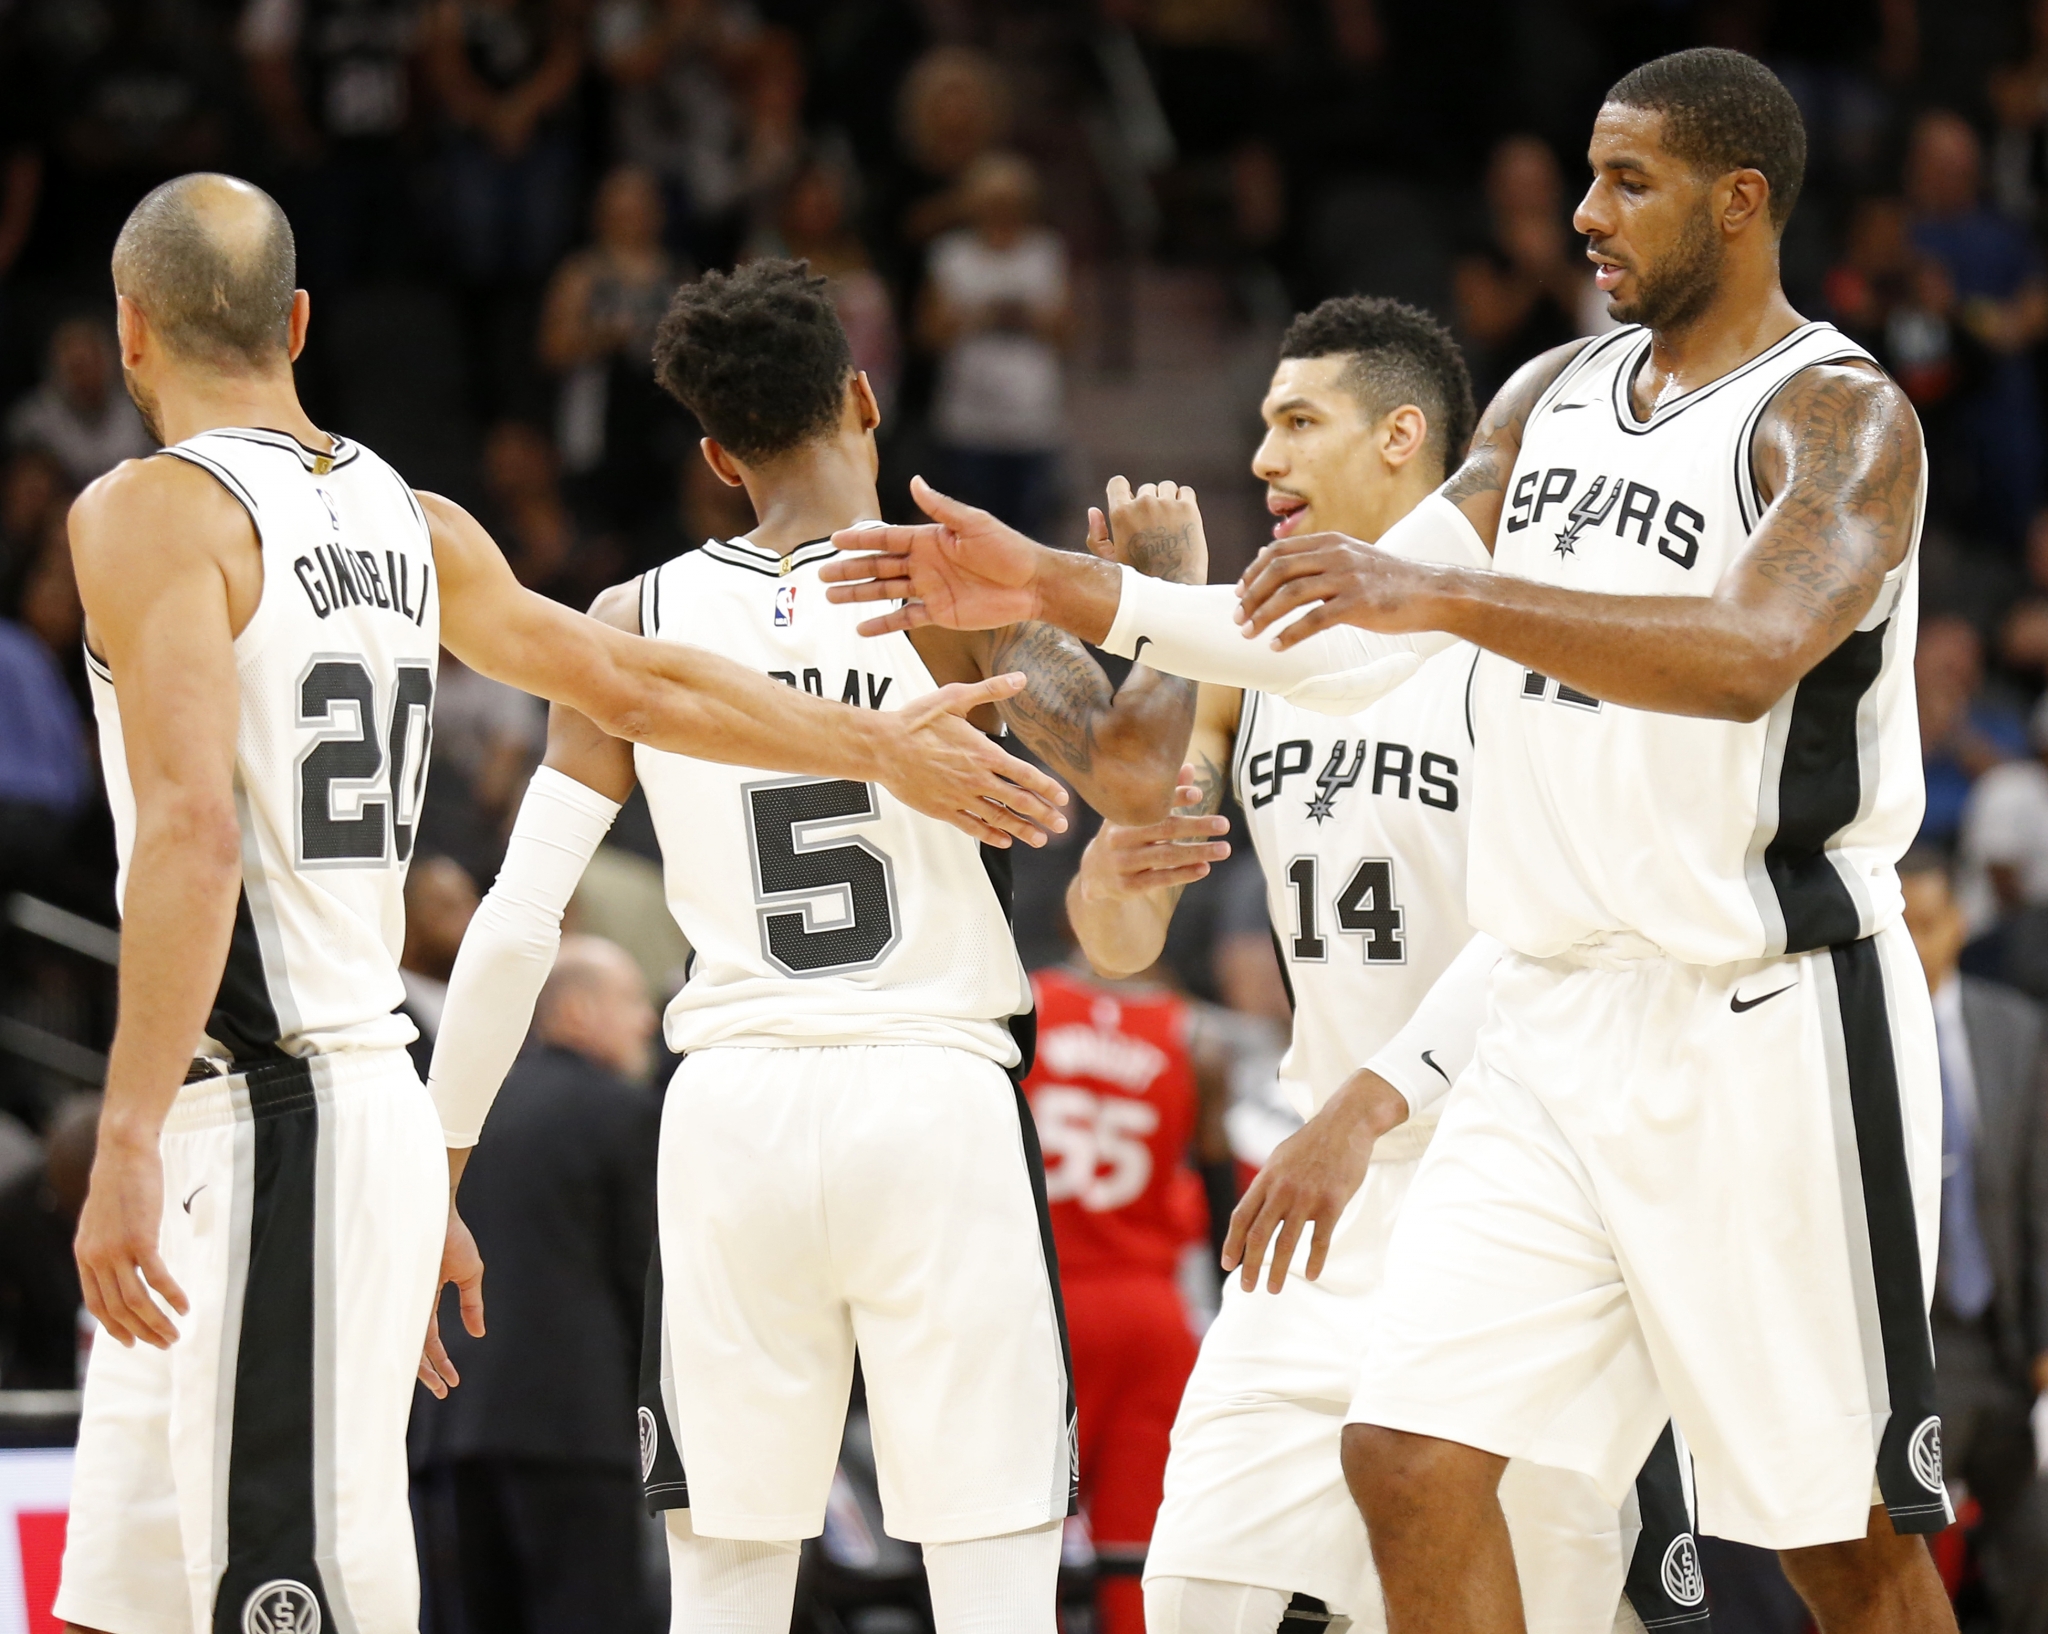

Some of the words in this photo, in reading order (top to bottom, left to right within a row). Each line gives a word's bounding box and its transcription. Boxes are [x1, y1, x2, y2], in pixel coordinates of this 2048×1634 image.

[1507, 468, 1705, 570] SPURS
[293, 542, 429, 627] GINOBILI
[294, 652, 436, 871] 20
[1250, 739, 1459, 826] SPURS
[740, 775, 903, 979] 5
[1286, 854, 1408, 965] 14
[1033, 1084, 1161, 1211] 55
